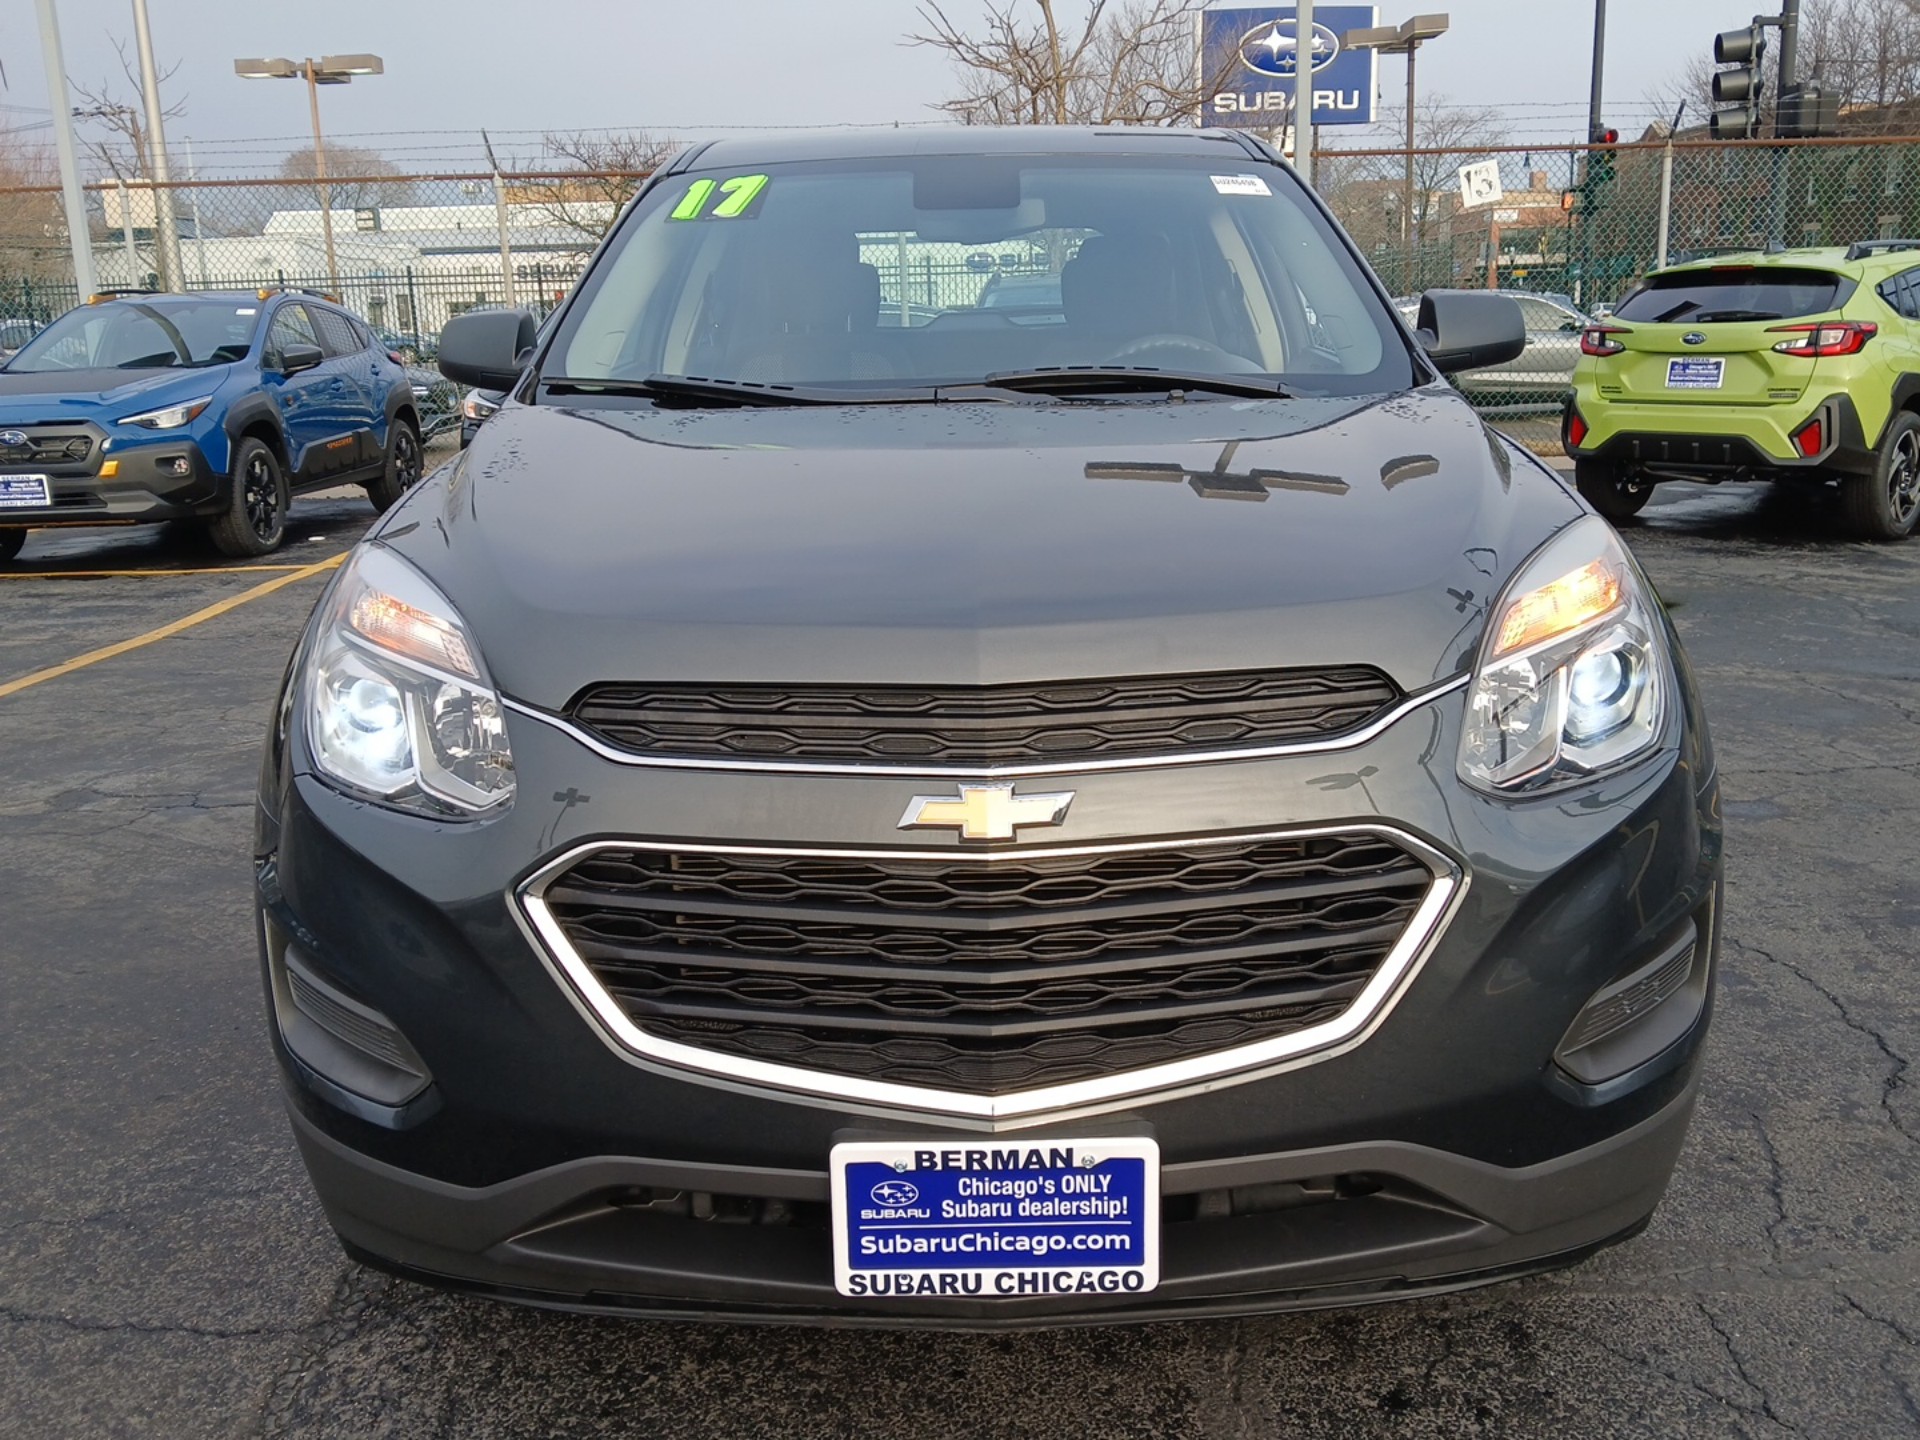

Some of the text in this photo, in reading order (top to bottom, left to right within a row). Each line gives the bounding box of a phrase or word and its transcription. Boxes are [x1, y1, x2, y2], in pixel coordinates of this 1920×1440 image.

[671, 173, 769, 219] 17
[914, 1148, 1074, 1171] BERMAN
[958, 1174, 1112, 1198] Chicago's ONLY
[861, 1208, 930, 1219] SUBARU
[942, 1196, 1128, 1218] Subaru dealership!
[860, 1231, 1131, 1255] SubaruChicago.com
[849, 1270, 1145, 1295] SUBARU CHICAGO
